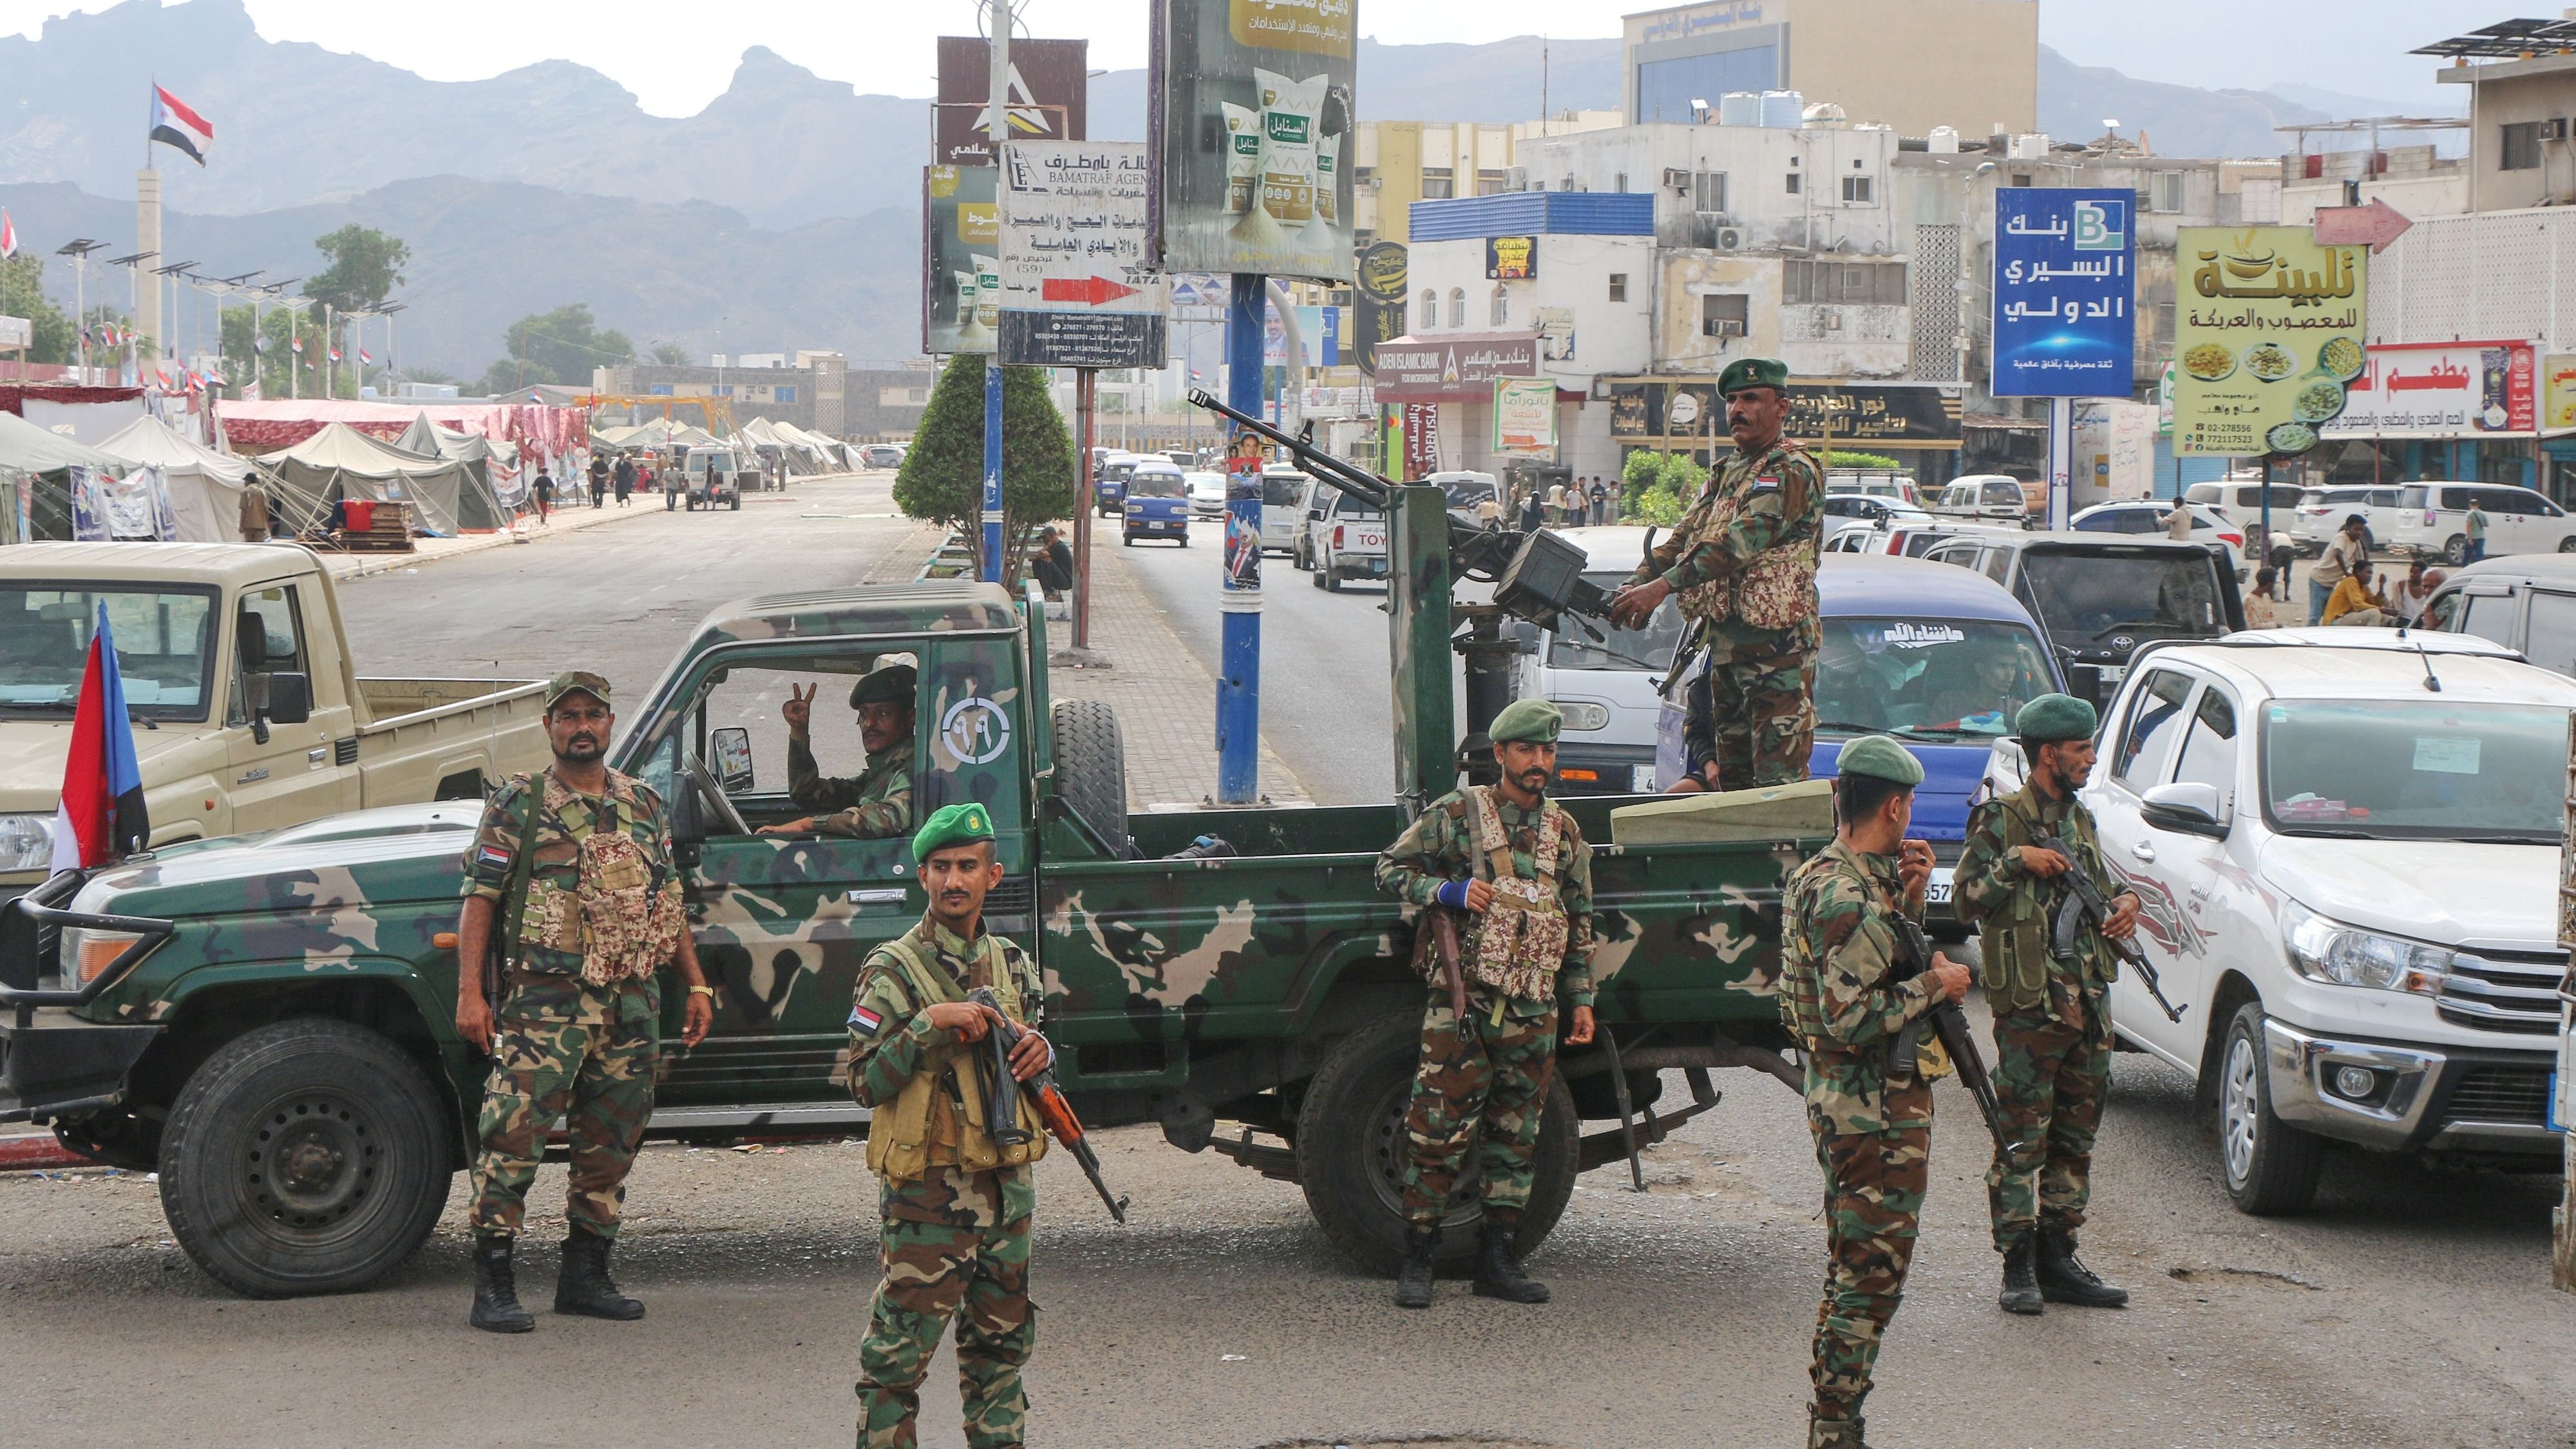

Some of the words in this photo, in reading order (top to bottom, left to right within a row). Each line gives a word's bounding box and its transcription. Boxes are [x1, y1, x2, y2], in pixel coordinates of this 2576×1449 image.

[1269, 116, 1306, 137] السنابل
[950, 142, 990, 159] سلامي
[1045, 154, 1110, 171] بامطرف
[1119, 155, 1146, 170] الة
[1049, 172, 1113, 184] BAMATRAF
[1116, 173, 1146, 185] AGEN
[1066, 214, 1106, 232] الحج
[1112, 213, 1146, 229] دمات
[2005, 214, 2069, 242] بنك
[1023, 254, 1052, 263] ترخيص
[1017, 265, 1043, 274] (59)
[2004, 255, 2124, 285] البسيري
[2194, 247, 2355, 307] تلبينة
[1125, 276, 1160, 285] IATA
[2003, 296, 2124, 324] الدولي
[2268, 308, 2357, 329] للمعصوب
[2190, 308, 2262, 330] والعريكة
[1379, 354, 1396, 370] ADEN
[1396, 353, 1420, 370] ISLAMIC
[1420, 352, 1439, 369] BANK
[1511, 346, 1530, 368] بنك
[2013, 360, 2039, 369] عالمية
[2063, 359, 2096, 370] مصرفية
[2098, 359, 2113, 368] ثقة
[1401, 374, 1410, 383] FOR
[1410, 374, 1439, 383] MICROFINANCE
[2387, 355, 2470, 404] مطعم
[1790, 394, 1857, 415] الطريق
[1860, 395, 1886, 416] نور
[1425, 402, 1437, 428] ISLA
[1783, 415, 1850, 437] السيارا
[2208, 424, 2251, 433] 02-278556
[2207, 435, 2253, 444] 772117523
[1358, 535, 1387, 545] TOY
